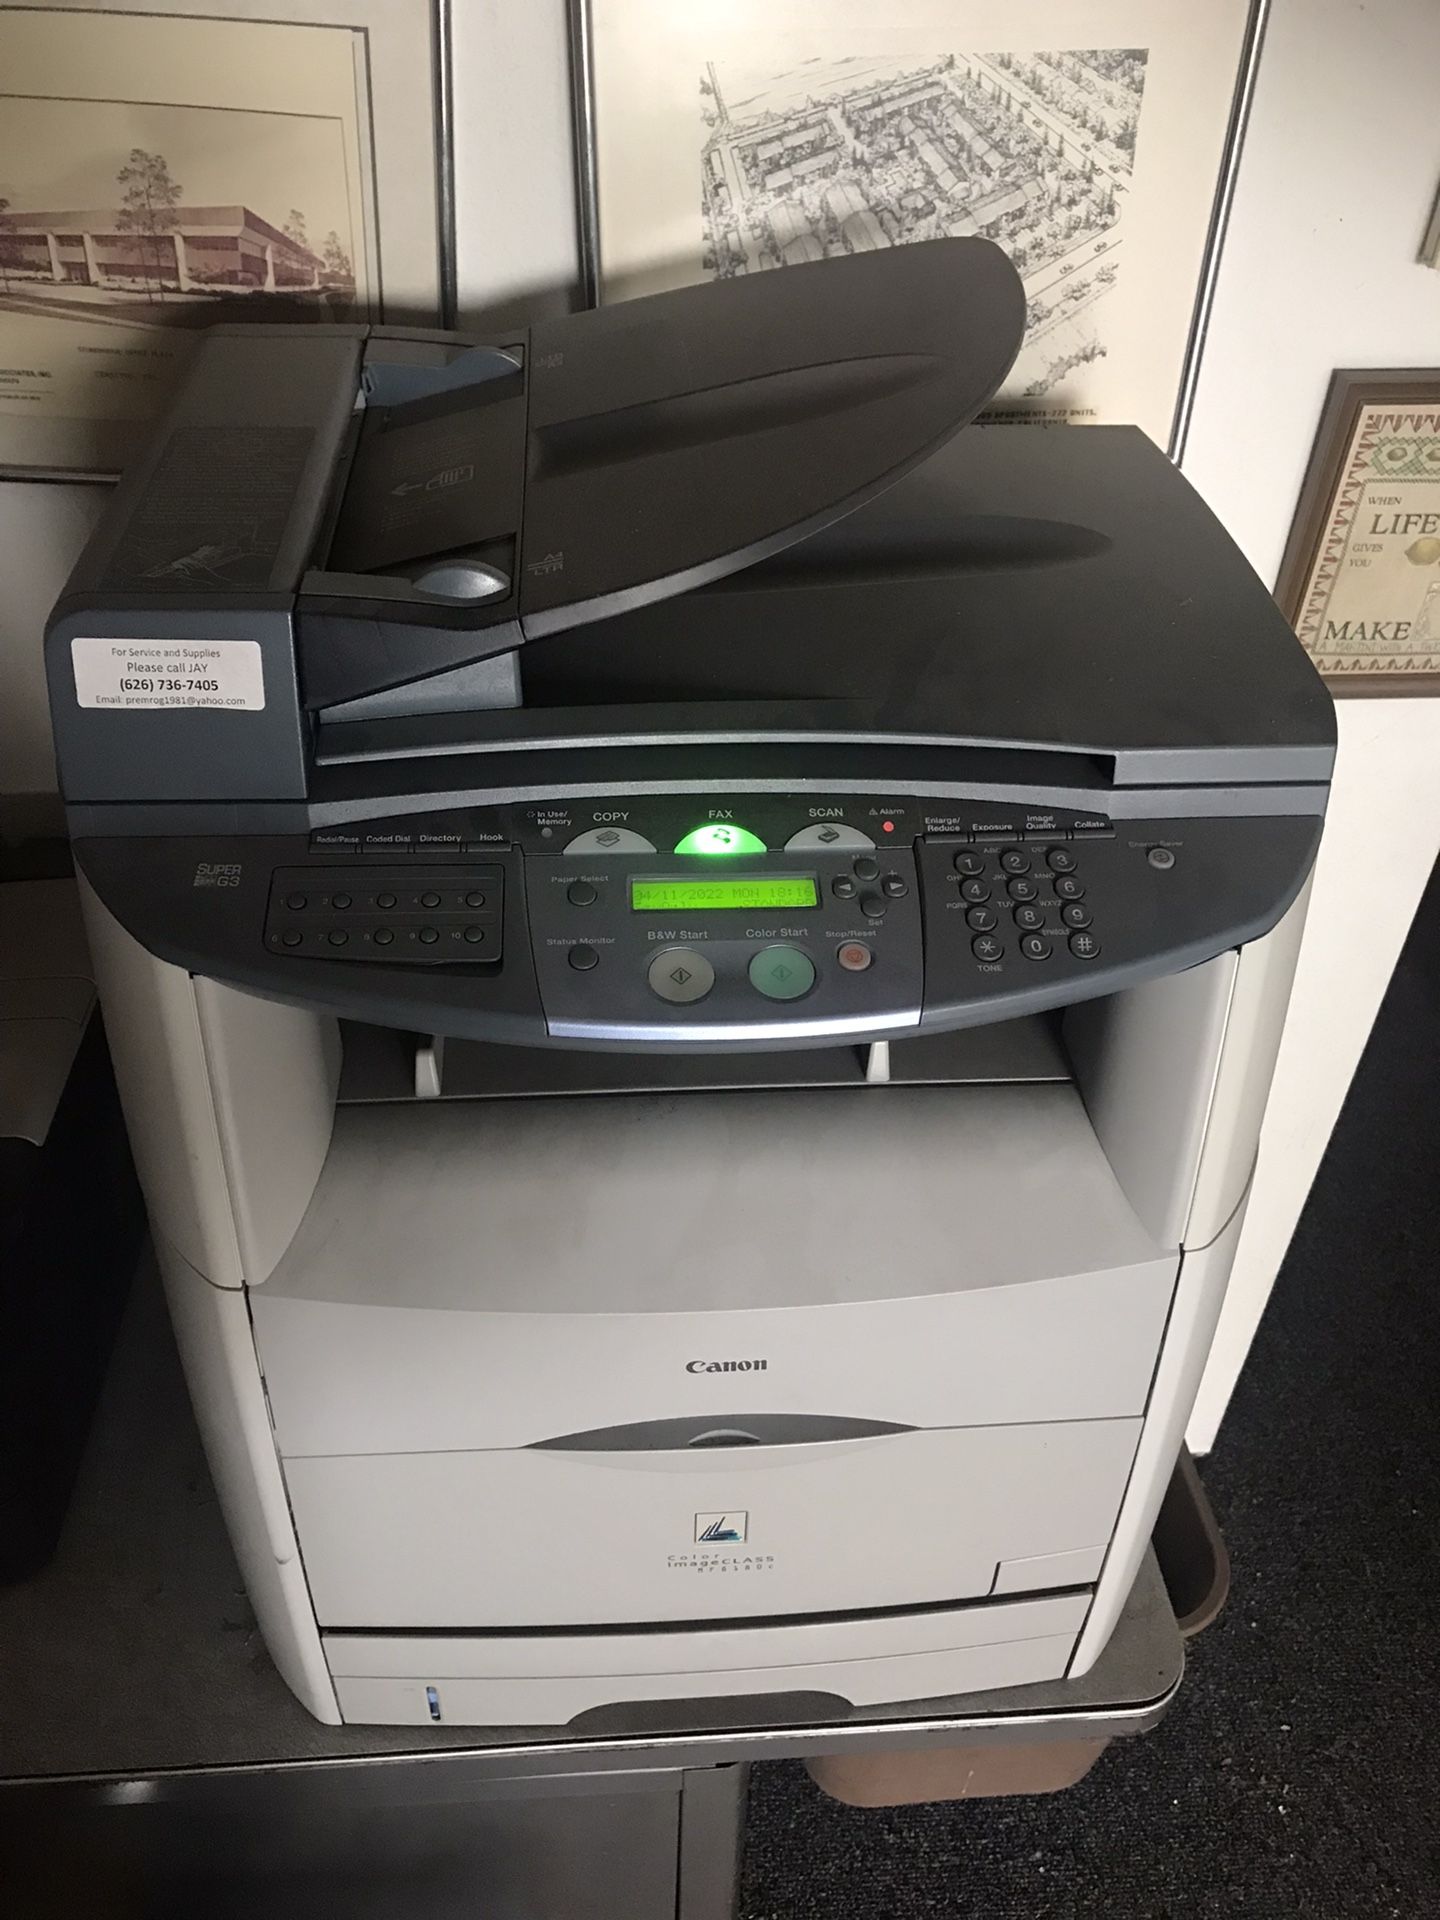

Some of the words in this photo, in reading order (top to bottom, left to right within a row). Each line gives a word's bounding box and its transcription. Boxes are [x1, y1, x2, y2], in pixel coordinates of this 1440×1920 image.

[1368, 496, 1402, 506] WHEN
[1369, 513, 1440, 535] LIFE
[1352, 543, 1384, 552] GIVES
[1349, 559, 1372, 568] YOU
[1324, 620, 1411, 641] MAKE
[111, 648, 127, 657] For
[129, 648, 161, 658] Service
[164, 648, 181, 658] and
[183, 649, 221, 659] Supplies
[127, 662, 164, 673] Please
[166, 663, 186, 673] call
[189, 663, 209, 673] JAY
[120, 678, 154, 692] (626)
[158, 680, 219, 691] 736-7405
[96, 695, 123, 704] Email:
[537, 811, 546, 819] In
[547, 811, 568, 819] Use/
[708, 810, 733, 819] FAX
[808, 808, 844, 818] SCAN
[879, 807, 905, 816] Alarm
[592, 812, 629, 822] COPY
[925, 816, 961, 825] Enlarge/
[1026, 814, 1054, 823] Image
[537, 818, 572, 827] Memory
[972, 823, 1013, 832] Exposure
[1026, 821, 1057, 830] Quality
[1074, 821, 1105, 829] Collate
[927, 824, 961, 832] Reduce
[366, 835, 394, 843] Coded
[395, 835, 411, 843] Dial
[419, 834, 462, 844] Directory
[479, 833, 504, 841] Hook
[964, 858, 973, 869] 1
[1010, 856, 1021, 867] 2
[1056, 854, 1068, 866] 3
[196, 863, 242, 876] SUPER
[217, 875, 241, 887] G3
[551, 876, 579, 885] Paper
[581, 875, 609, 883] Select
[971, 883, 981, 895] 4
[1017, 882, 1028, 894] 5
[1064, 881, 1075, 893] 6
[732, 887, 760, 899] MON
[976, 912, 986, 924] 7
[1024, 910, 1035, 923] 8
[1072, 909, 1083, 921] 9
[868, 918, 884, 926] Set
[647, 930, 676, 941] B&W
[679, 930, 708, 939] Start
[745, 928, 775, 938] Color
[778, 927, 808, 938] Start
[825, 929, 877, 939] Stop/Reset
[546, 937, 578, 946] Status
[580, 936, 616, 945] Monitor
[1030, 939, 1042, 953] 0
[1077, 936, 1093, 952] #
[977, 964, 1003, 973] TONE
[685, 1359, 768, 1374] Canon
[667, 1553, 719, 1562] Color
[667, 1555, 775, 1569] imageCLASS
